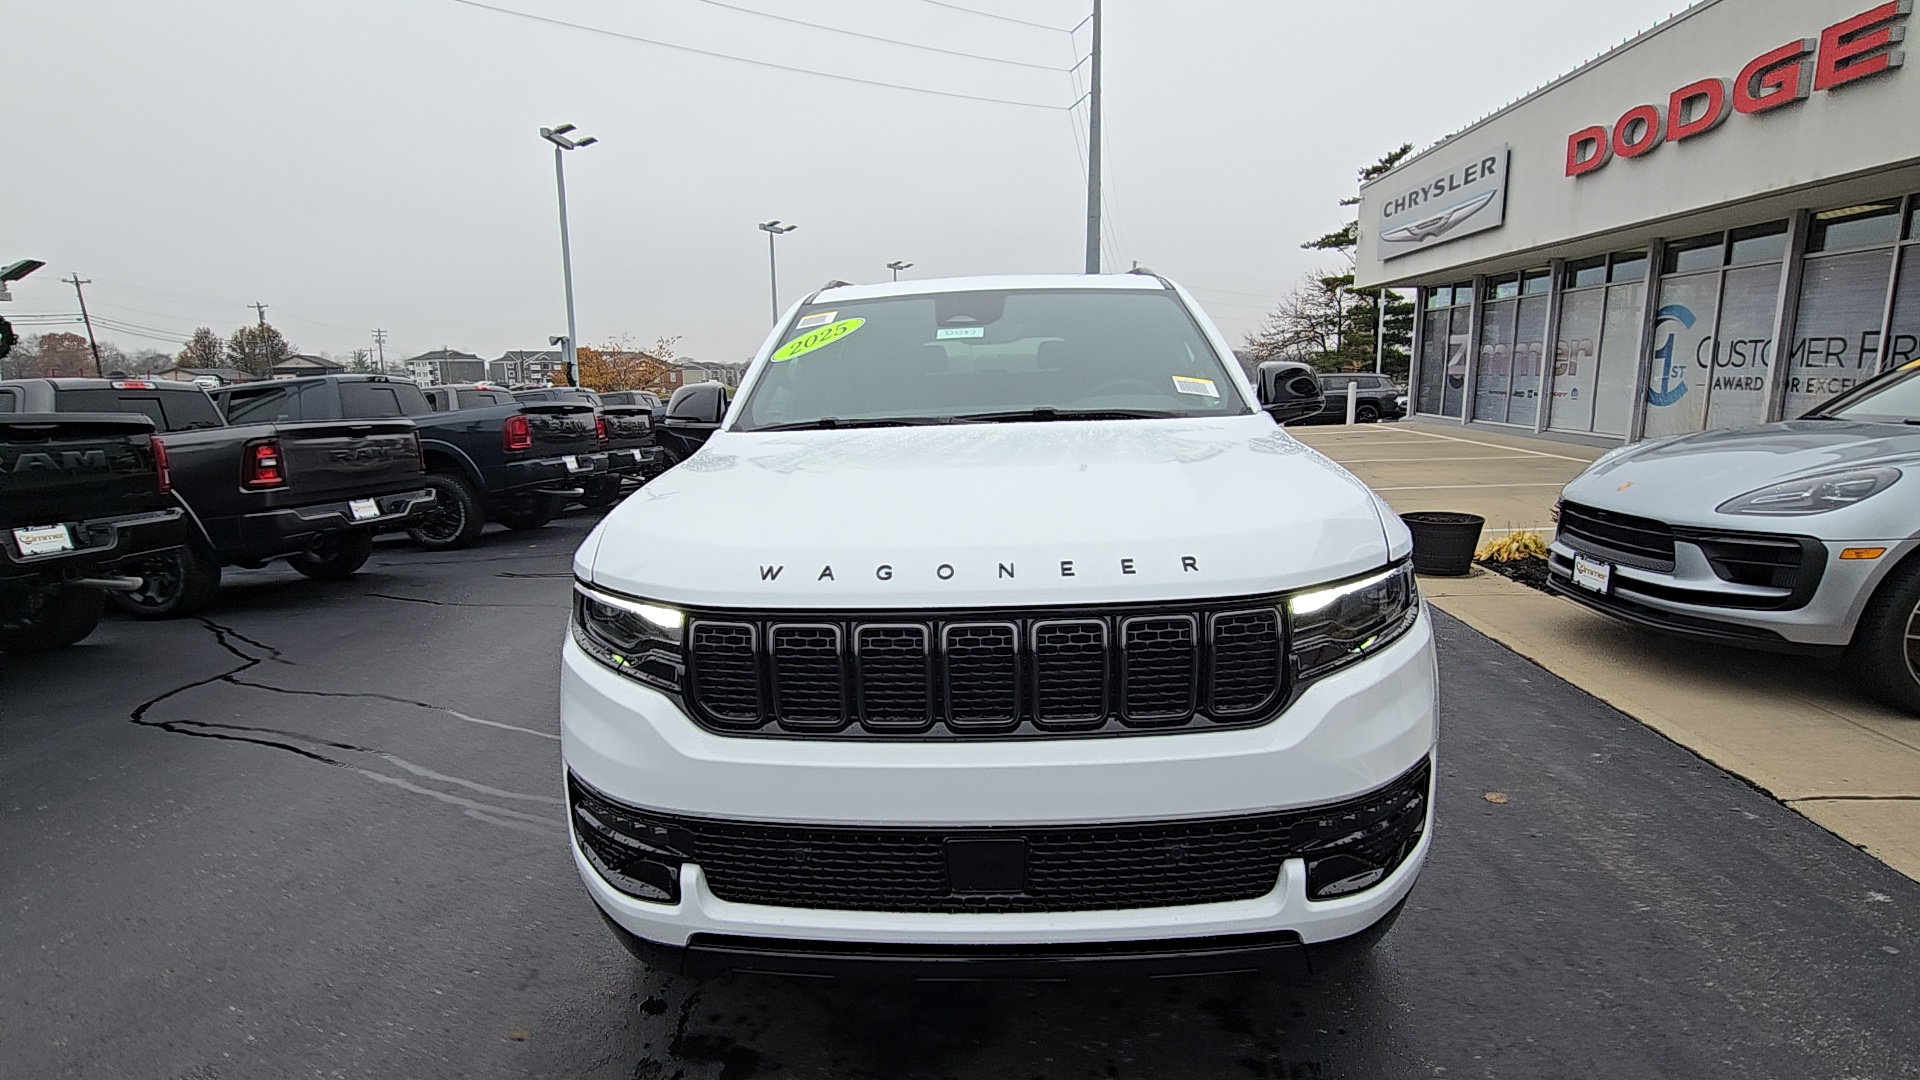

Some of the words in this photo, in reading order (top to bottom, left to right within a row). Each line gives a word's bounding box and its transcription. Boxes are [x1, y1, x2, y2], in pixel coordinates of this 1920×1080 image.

[1565, 0, 1903, 177] DODGE
[1383, 156, 1497, 218] CHRYSLER
[789, 321, 849, 357] 2025
[1447, 334, 1594, 377] Zmmer
[1857, 330, 1920, 369] FIR
[1713, 376, 1764, 392] AWARD
[0, 450, 108, 474] AM
[759, 555, 1199, 581] WAGONEER
